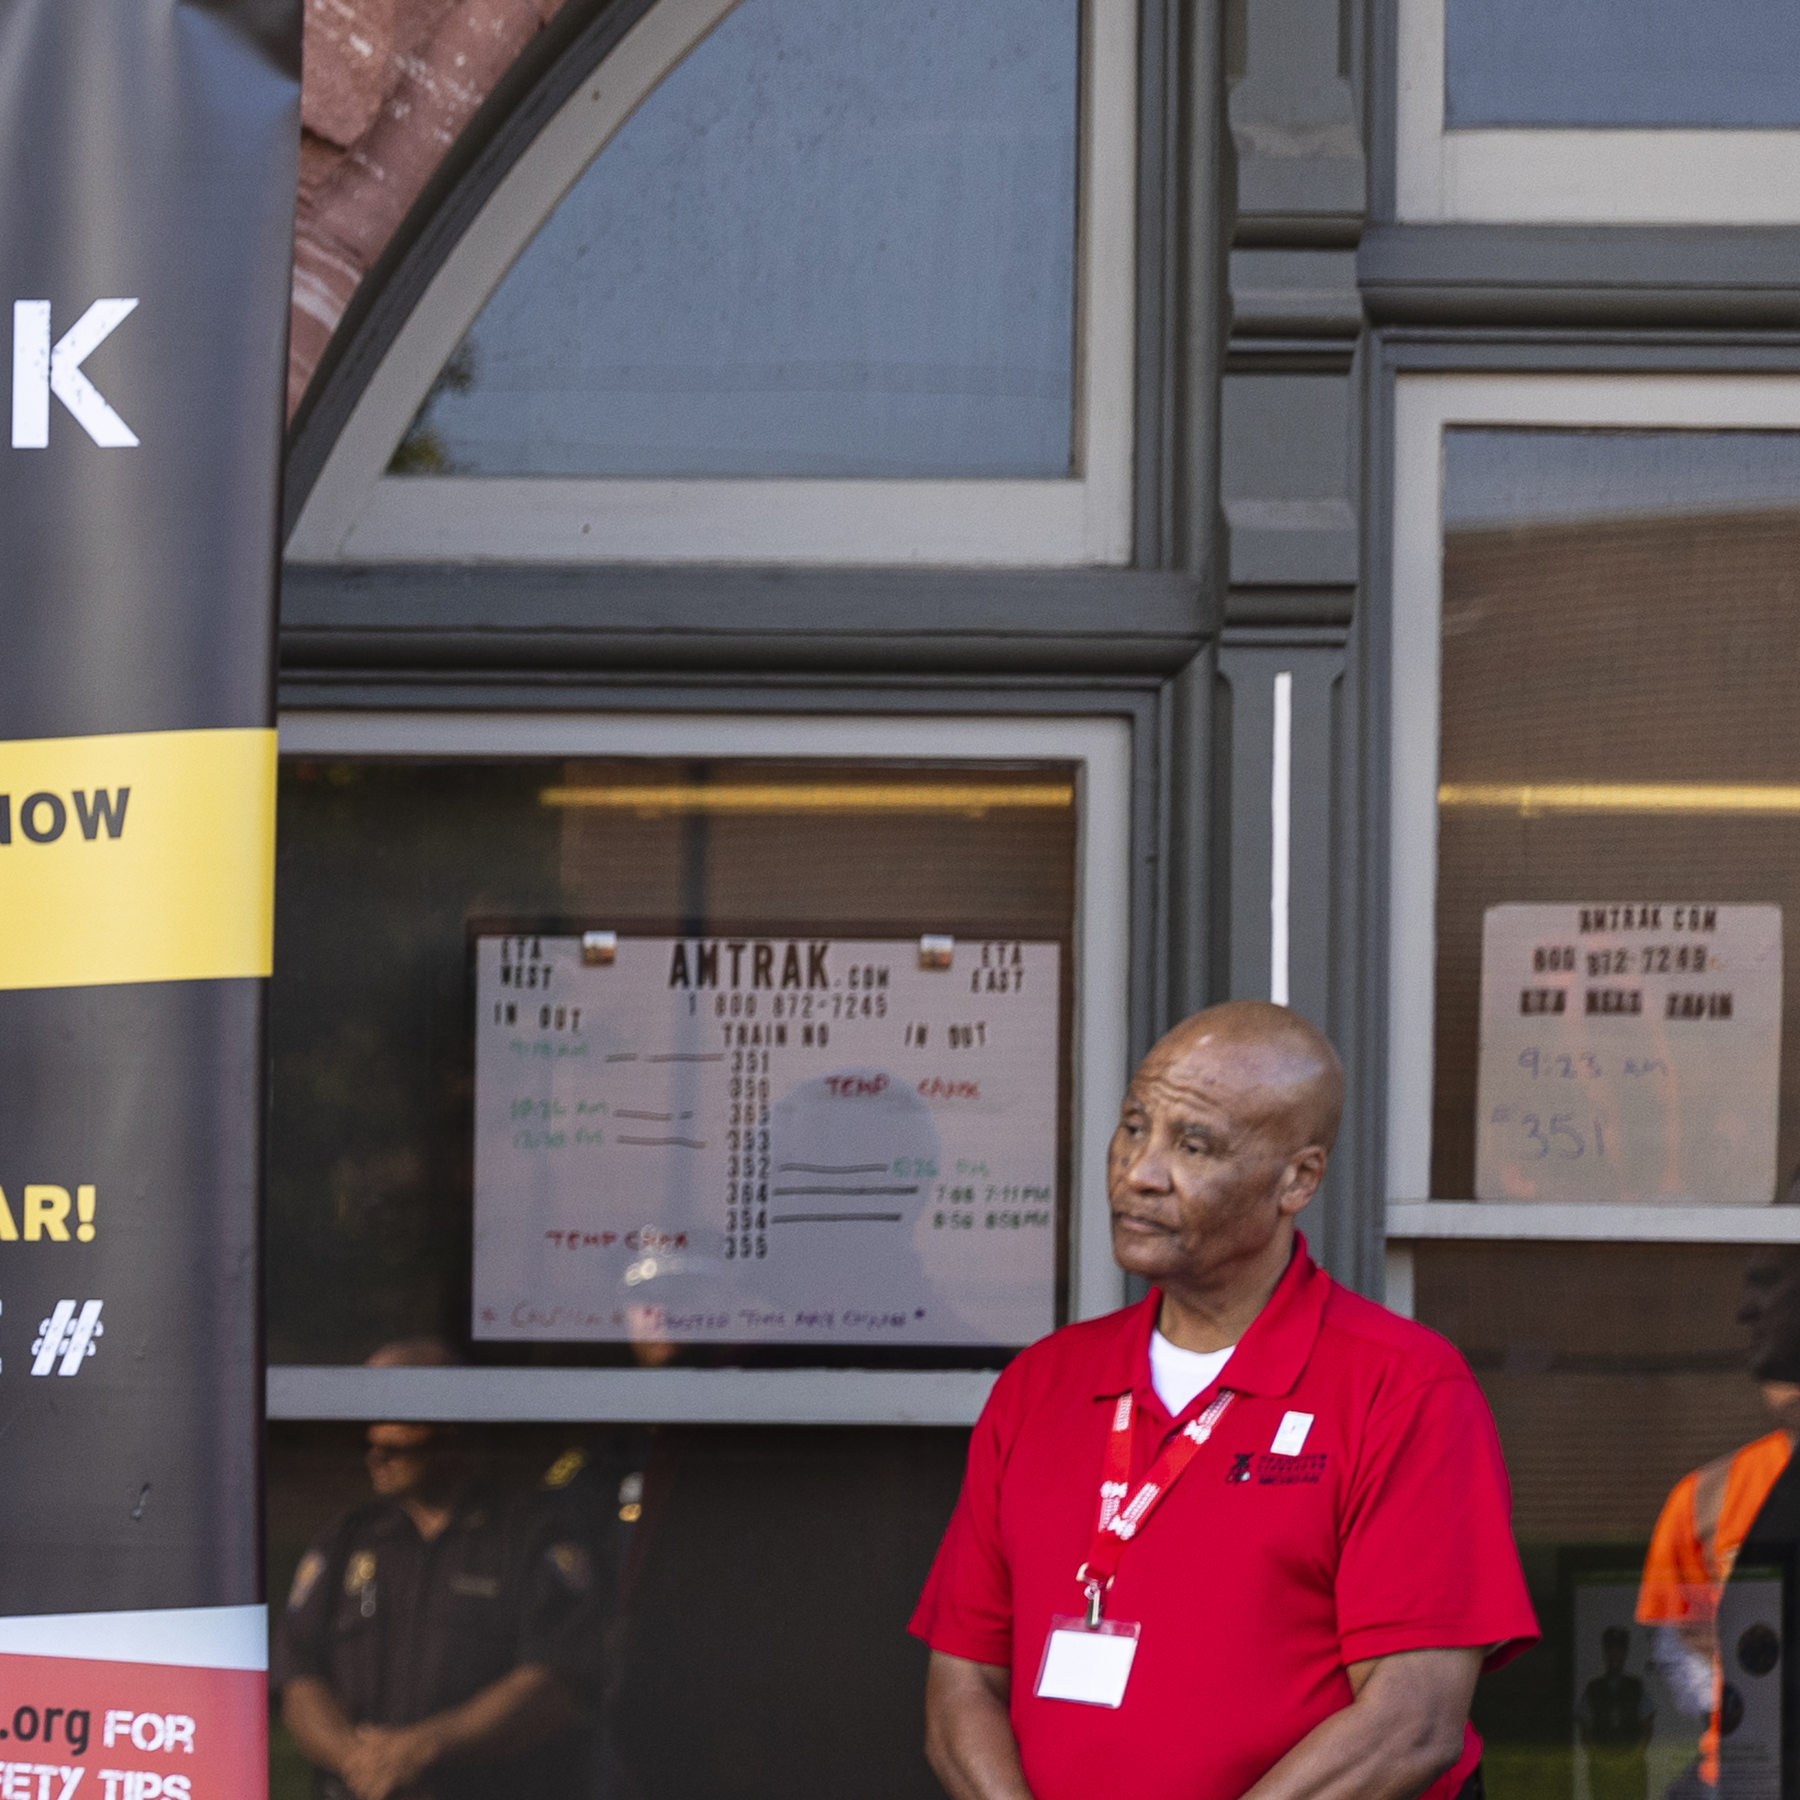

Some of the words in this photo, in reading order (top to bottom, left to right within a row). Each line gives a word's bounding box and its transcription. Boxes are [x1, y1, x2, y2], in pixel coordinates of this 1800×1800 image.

[669, 942, 830, 990] AMTRAK
[721, 1020, 789, 1049] TRAIN
[102, 1708, 197, 1754] FOR
